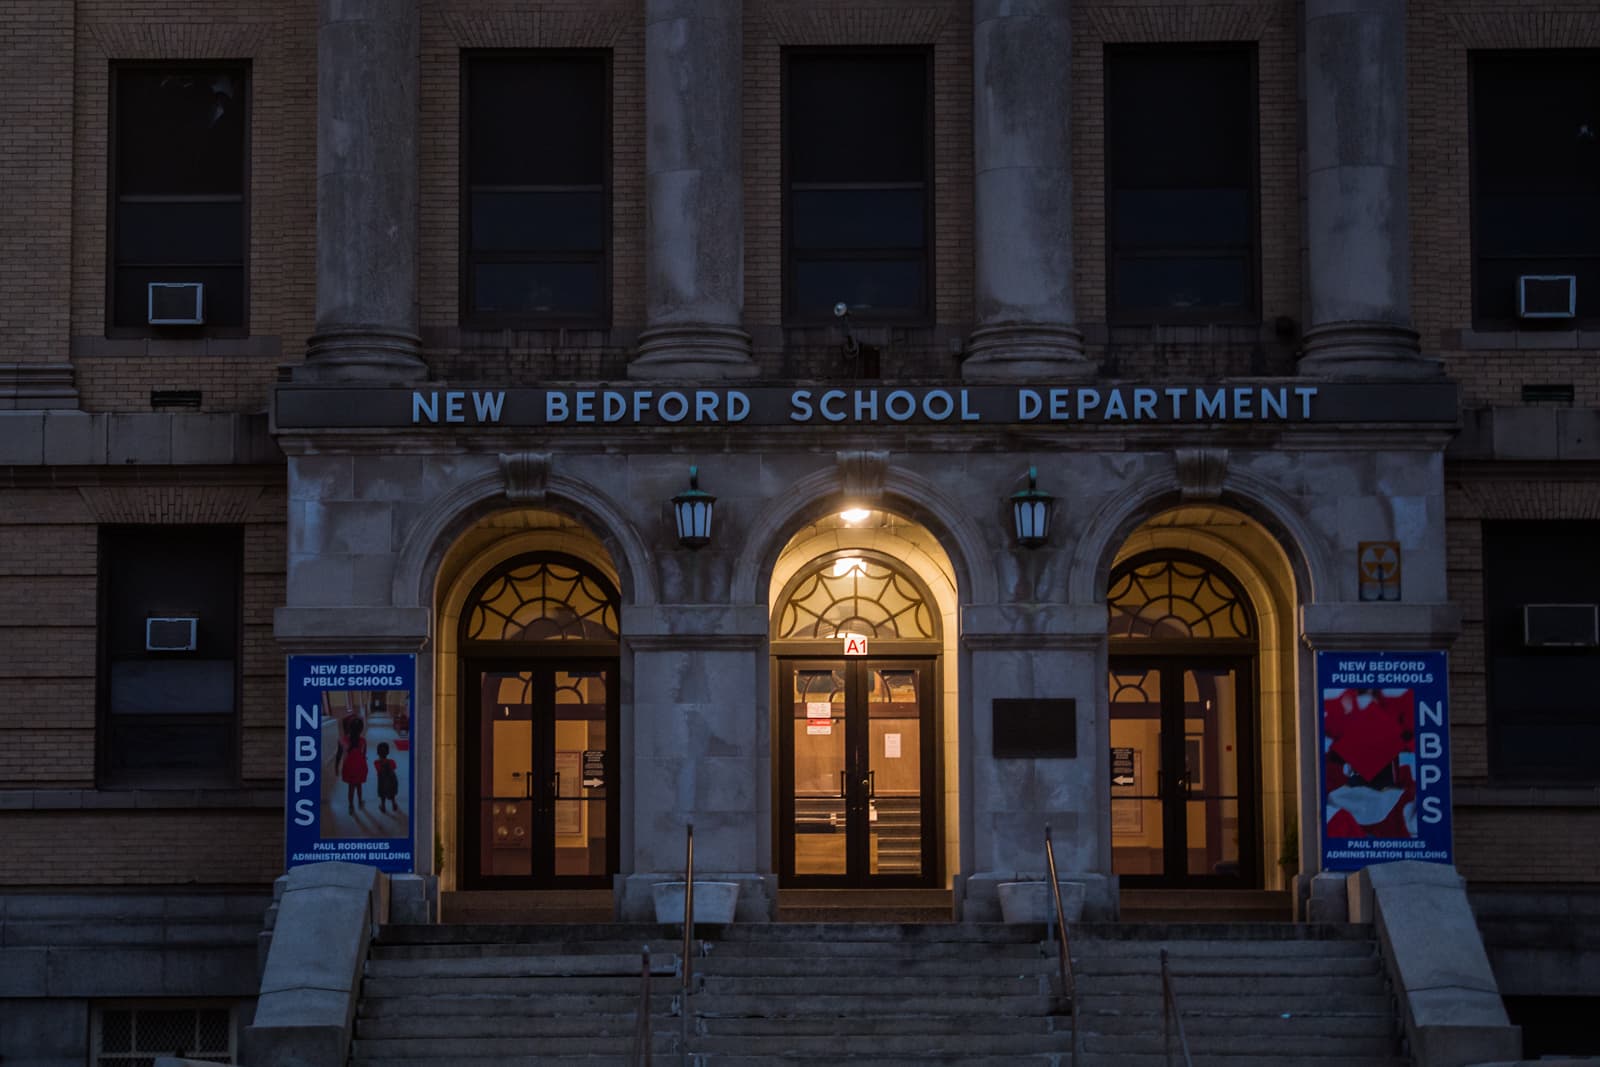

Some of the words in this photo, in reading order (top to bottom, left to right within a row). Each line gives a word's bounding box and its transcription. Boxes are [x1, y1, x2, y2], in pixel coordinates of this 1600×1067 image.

[411, 390, 506, 424] NEW
[545, 390, 751, 424] BEDFORD
[789, 389, 981, 422] SCHOOL
[1018, 387, 1319, 421] DEPARTMENT
[847, 639, 866, 654] A1
[310, 664, 338, 675] NEW
[340, 664, 396, 674] BEDFORD
[1339, 660, 1366, 671] NEW
[1369, 660, 1426, 671] BEDFORD
[303, 677, 346, 687] PUBLIC
[347, 676, 403, 686] SCHOOLS
[1331, 673, 1375, 683] PUBLIC
[1377, 673, 1434, 684] SCHOOLS
[294, 704, 319, 827] NBPS
[1418, 699, 1443, 824] NBPS
[312, 842, 336, 851] PAUL
[337, 842, 390, 850] RODRIGUES
[1347, 840, 1371, 849] PAUL
[1372, 840, 1426, 849] RODRIGUES
[292, 852, 366, 861] ADMINISTRATION
[368, 852, 411, 860] BUILDING
[1326, 851, 1402, 859] ADMINISTRATION
[1404, 851, 1448, 860] BUILDING
